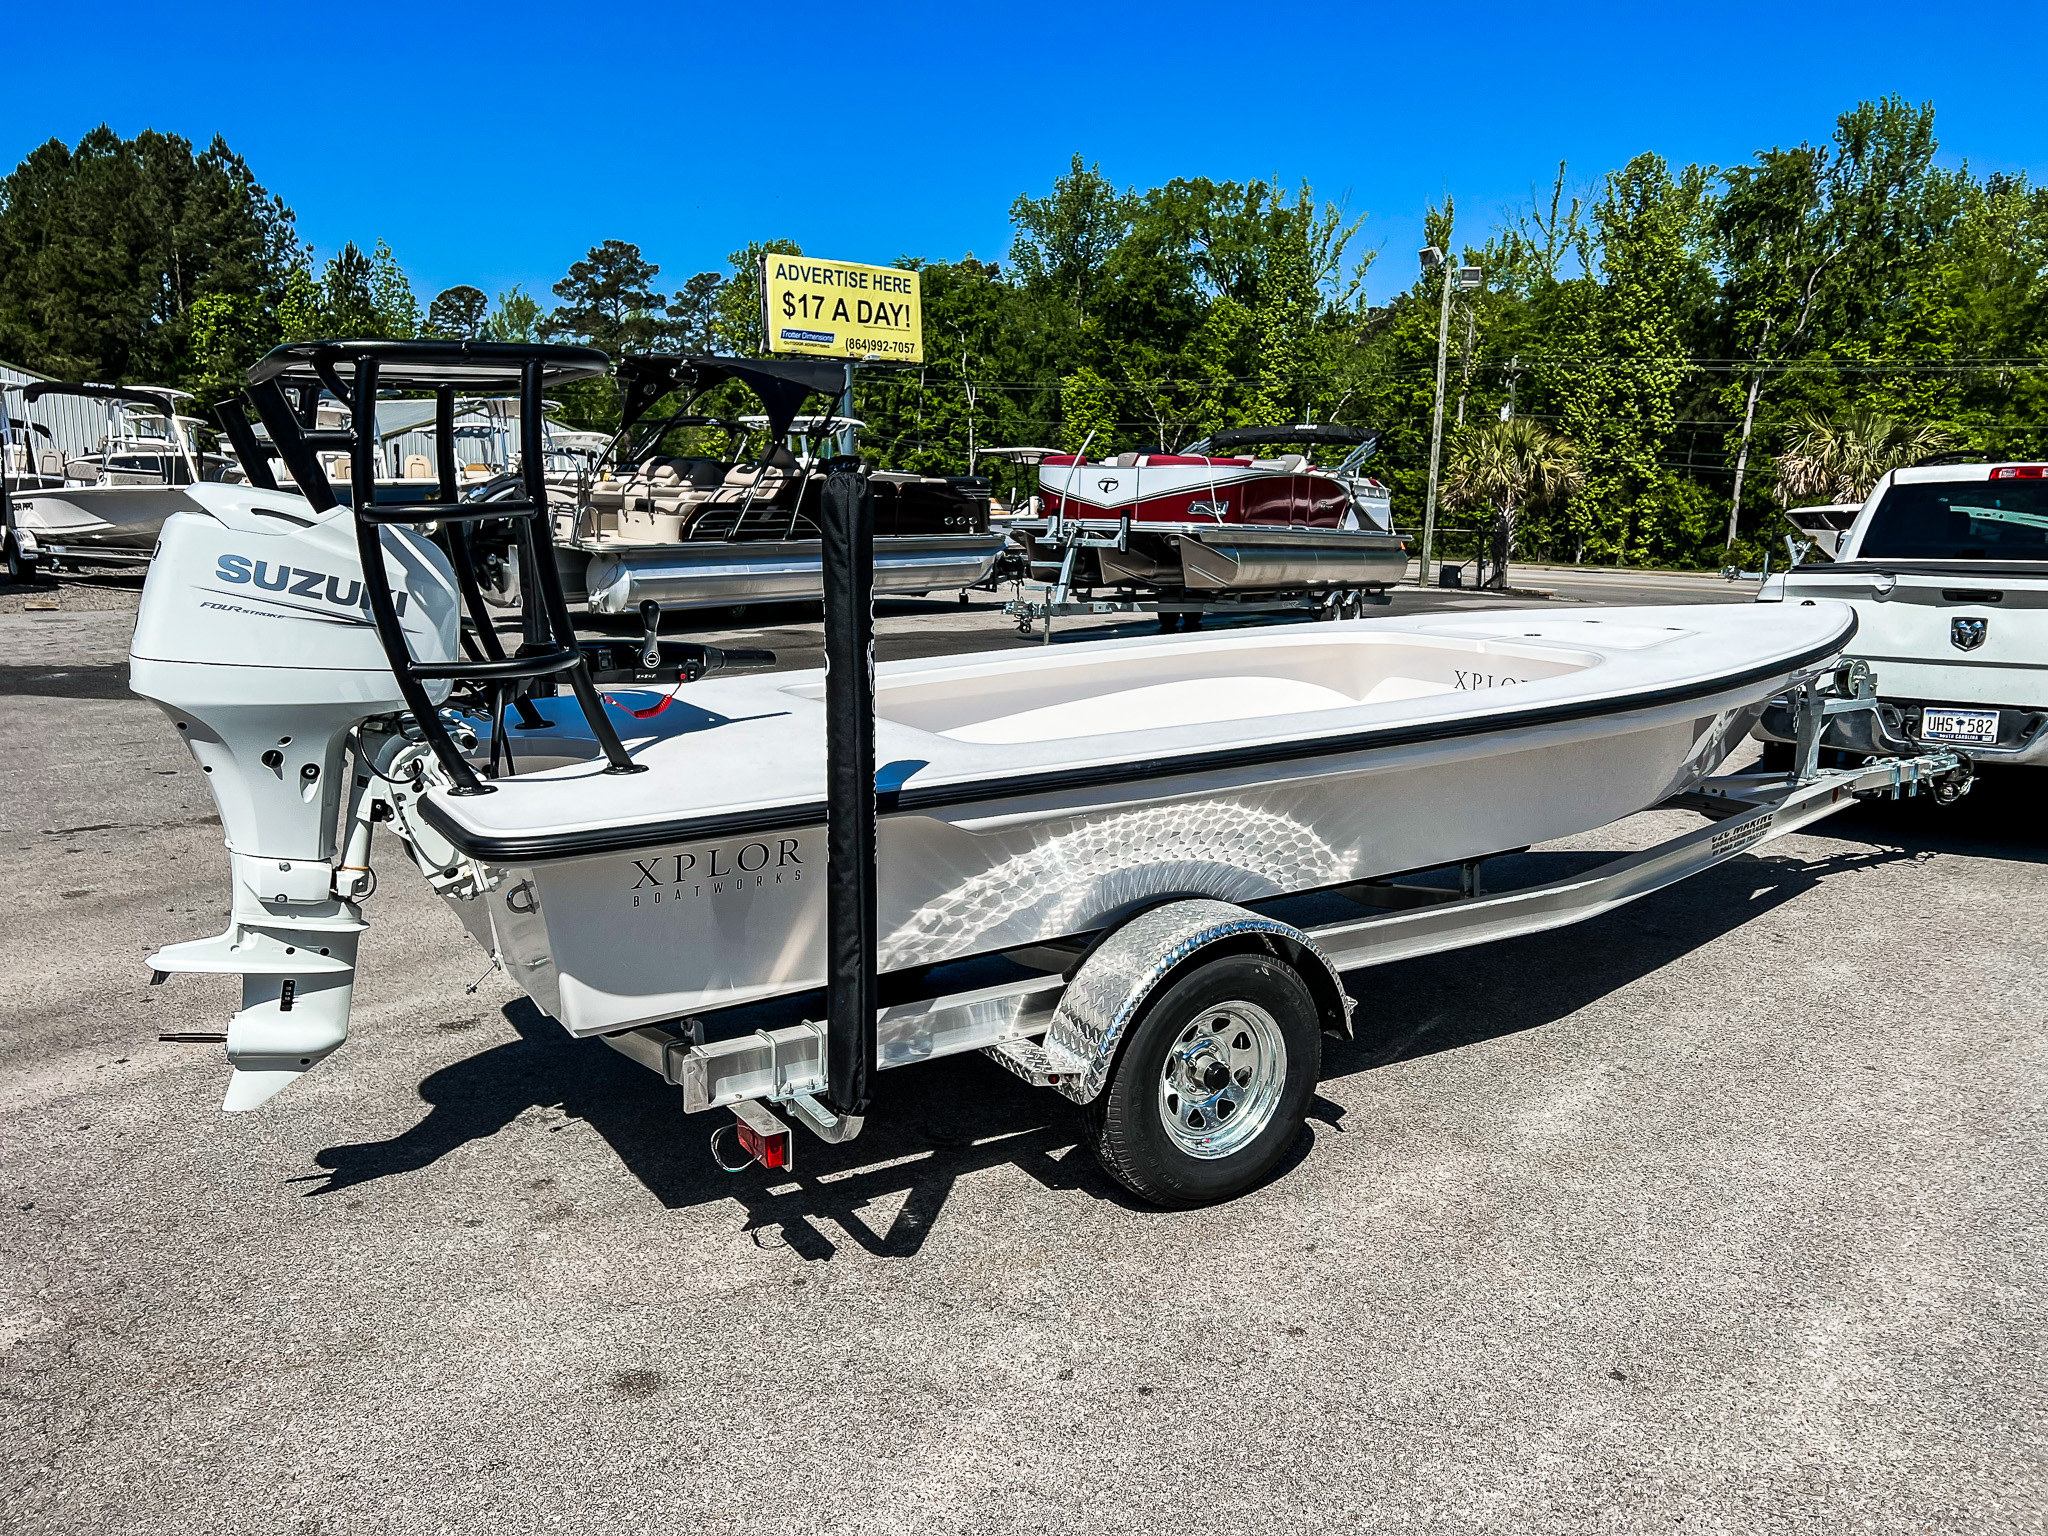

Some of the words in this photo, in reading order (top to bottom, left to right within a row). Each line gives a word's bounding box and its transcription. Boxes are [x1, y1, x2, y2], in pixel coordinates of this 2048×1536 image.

[775, 263, 869, 290] ADVERTISE
[873, 273, 912, 294] HERE
[782, 290, 825, 320] $17
[831, 298, 850, 322] A
[857, 299, 910, 328] DAY!
[845, 337, 915, 354] (864)992-7057
[200, 601, 242, 614] FOUR
[241, 608, 285, 620] STROKE
[1454, 669, 1528, 690] XPL
[1928, 716, 1954, 732] UHS
[1967, 718, 1993, 734] 582
[630, 840, 804, 890] XPLOR
[633, 869, 801, 907] BOATWORKS
